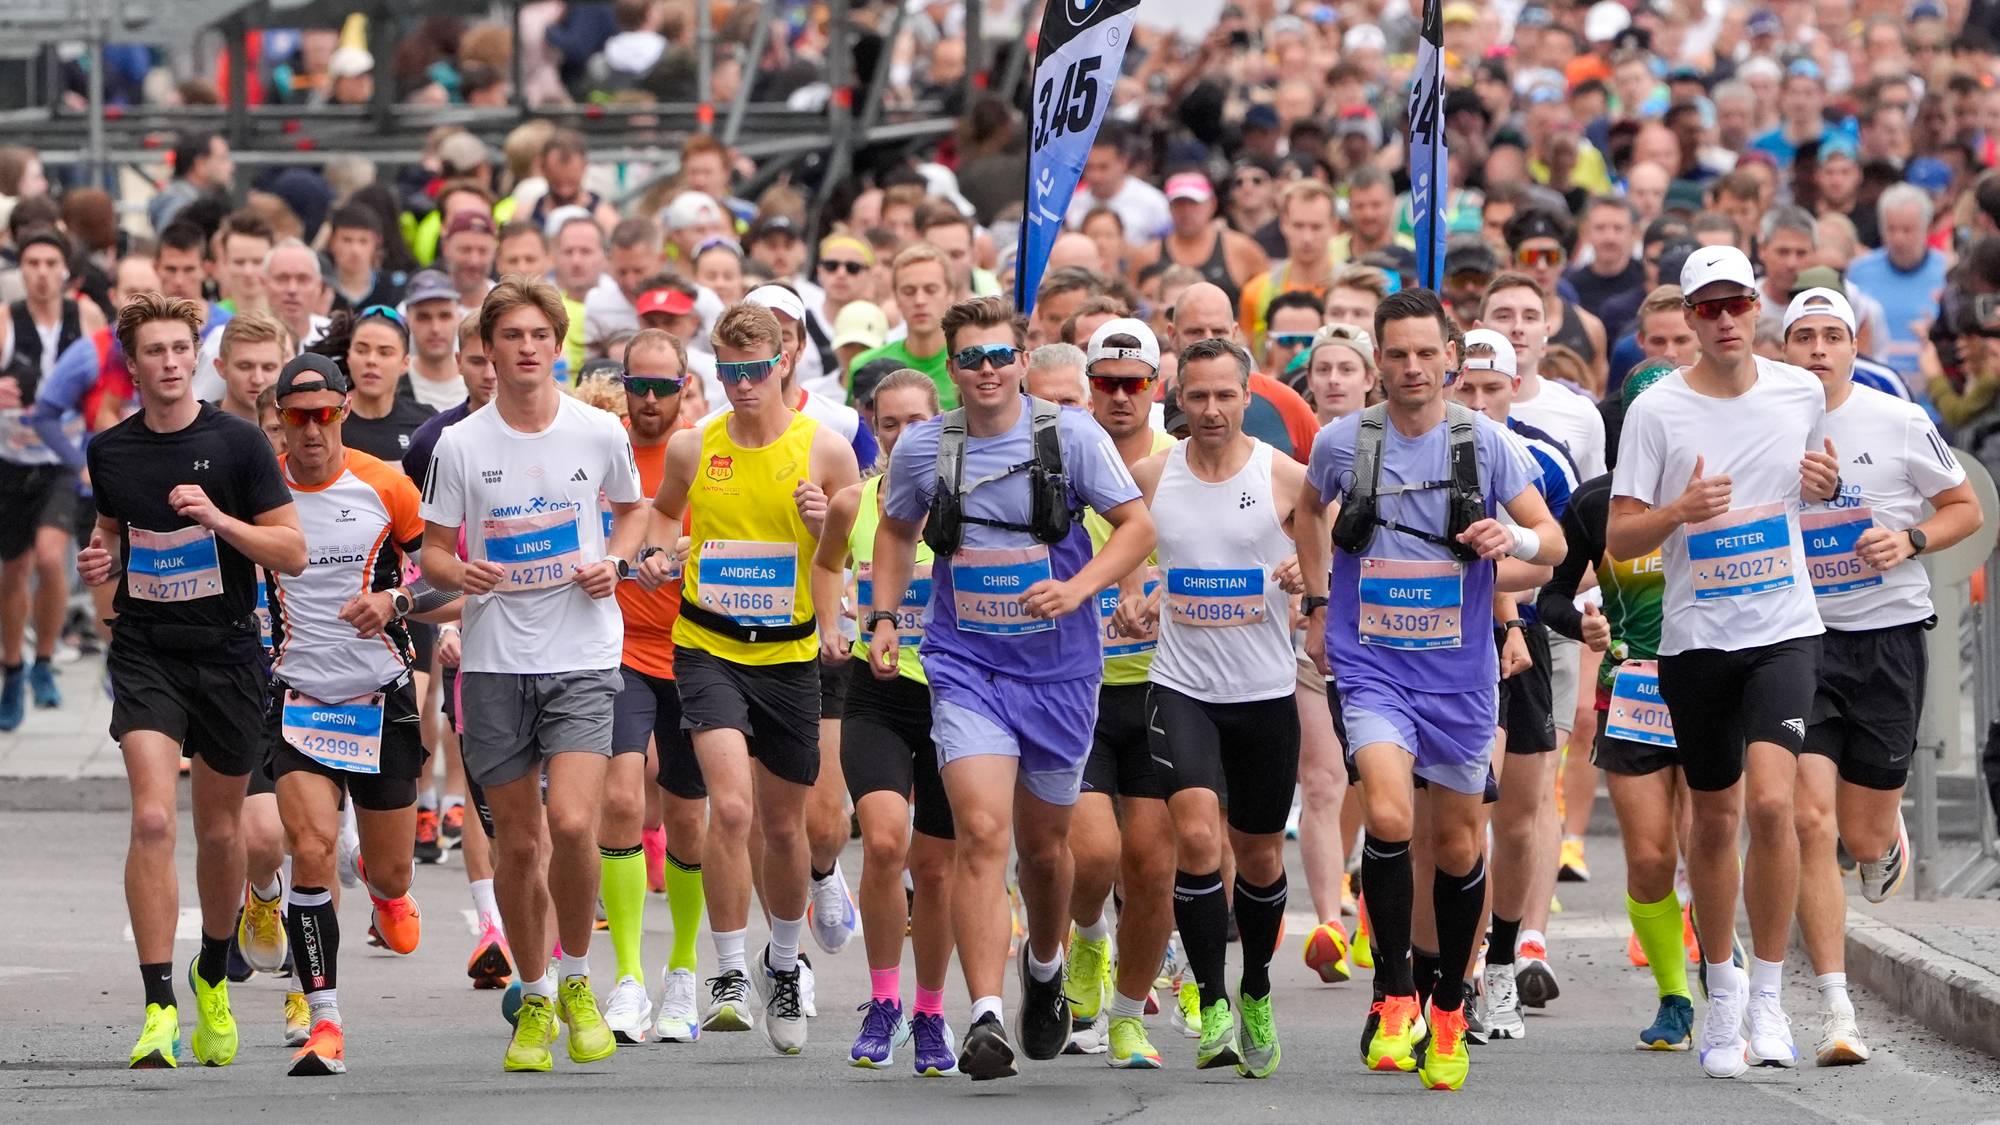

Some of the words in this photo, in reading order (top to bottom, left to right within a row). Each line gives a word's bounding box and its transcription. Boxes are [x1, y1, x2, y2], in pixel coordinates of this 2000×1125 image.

[1034, 55, 1102, 153] 3.45
[491, 505, 521, 518] BMW
[550, 502, 581, 512] OSO
[515, 539, 552, 555] LINUS
[1716, 532, 1765, 550] PETTER
[1813, 538, 1839, 550] OLA
[153, 556, 185, 570] HAUK
[309, 554, 365, 565] LANDA
[511, 562, 564, 585] 42718
[720, 566, 776, 580] ANDRÉAS
[1714, 557, 1775, 582] 42027
[1807, 558, 1862, 580] 0505
[148, 578, 198, 599] 42717
[983, 575, 1020, 586] CHRIS
[1183, 576, 1247, 589] CHRISTIAN
[720, 592, 774, 610] 41666
[1389, 587, 1432, 600] GAUTE
[1101, 597, 1120, 609] ES
[1185, 602, 1246, 621] 40984
[1380, 612, 1440, 632] 43097
[311, 711, 356, 726] CORSIN
[1631, 707, 1674, 729] 4010
[303, 735, 360, 757] 42999
